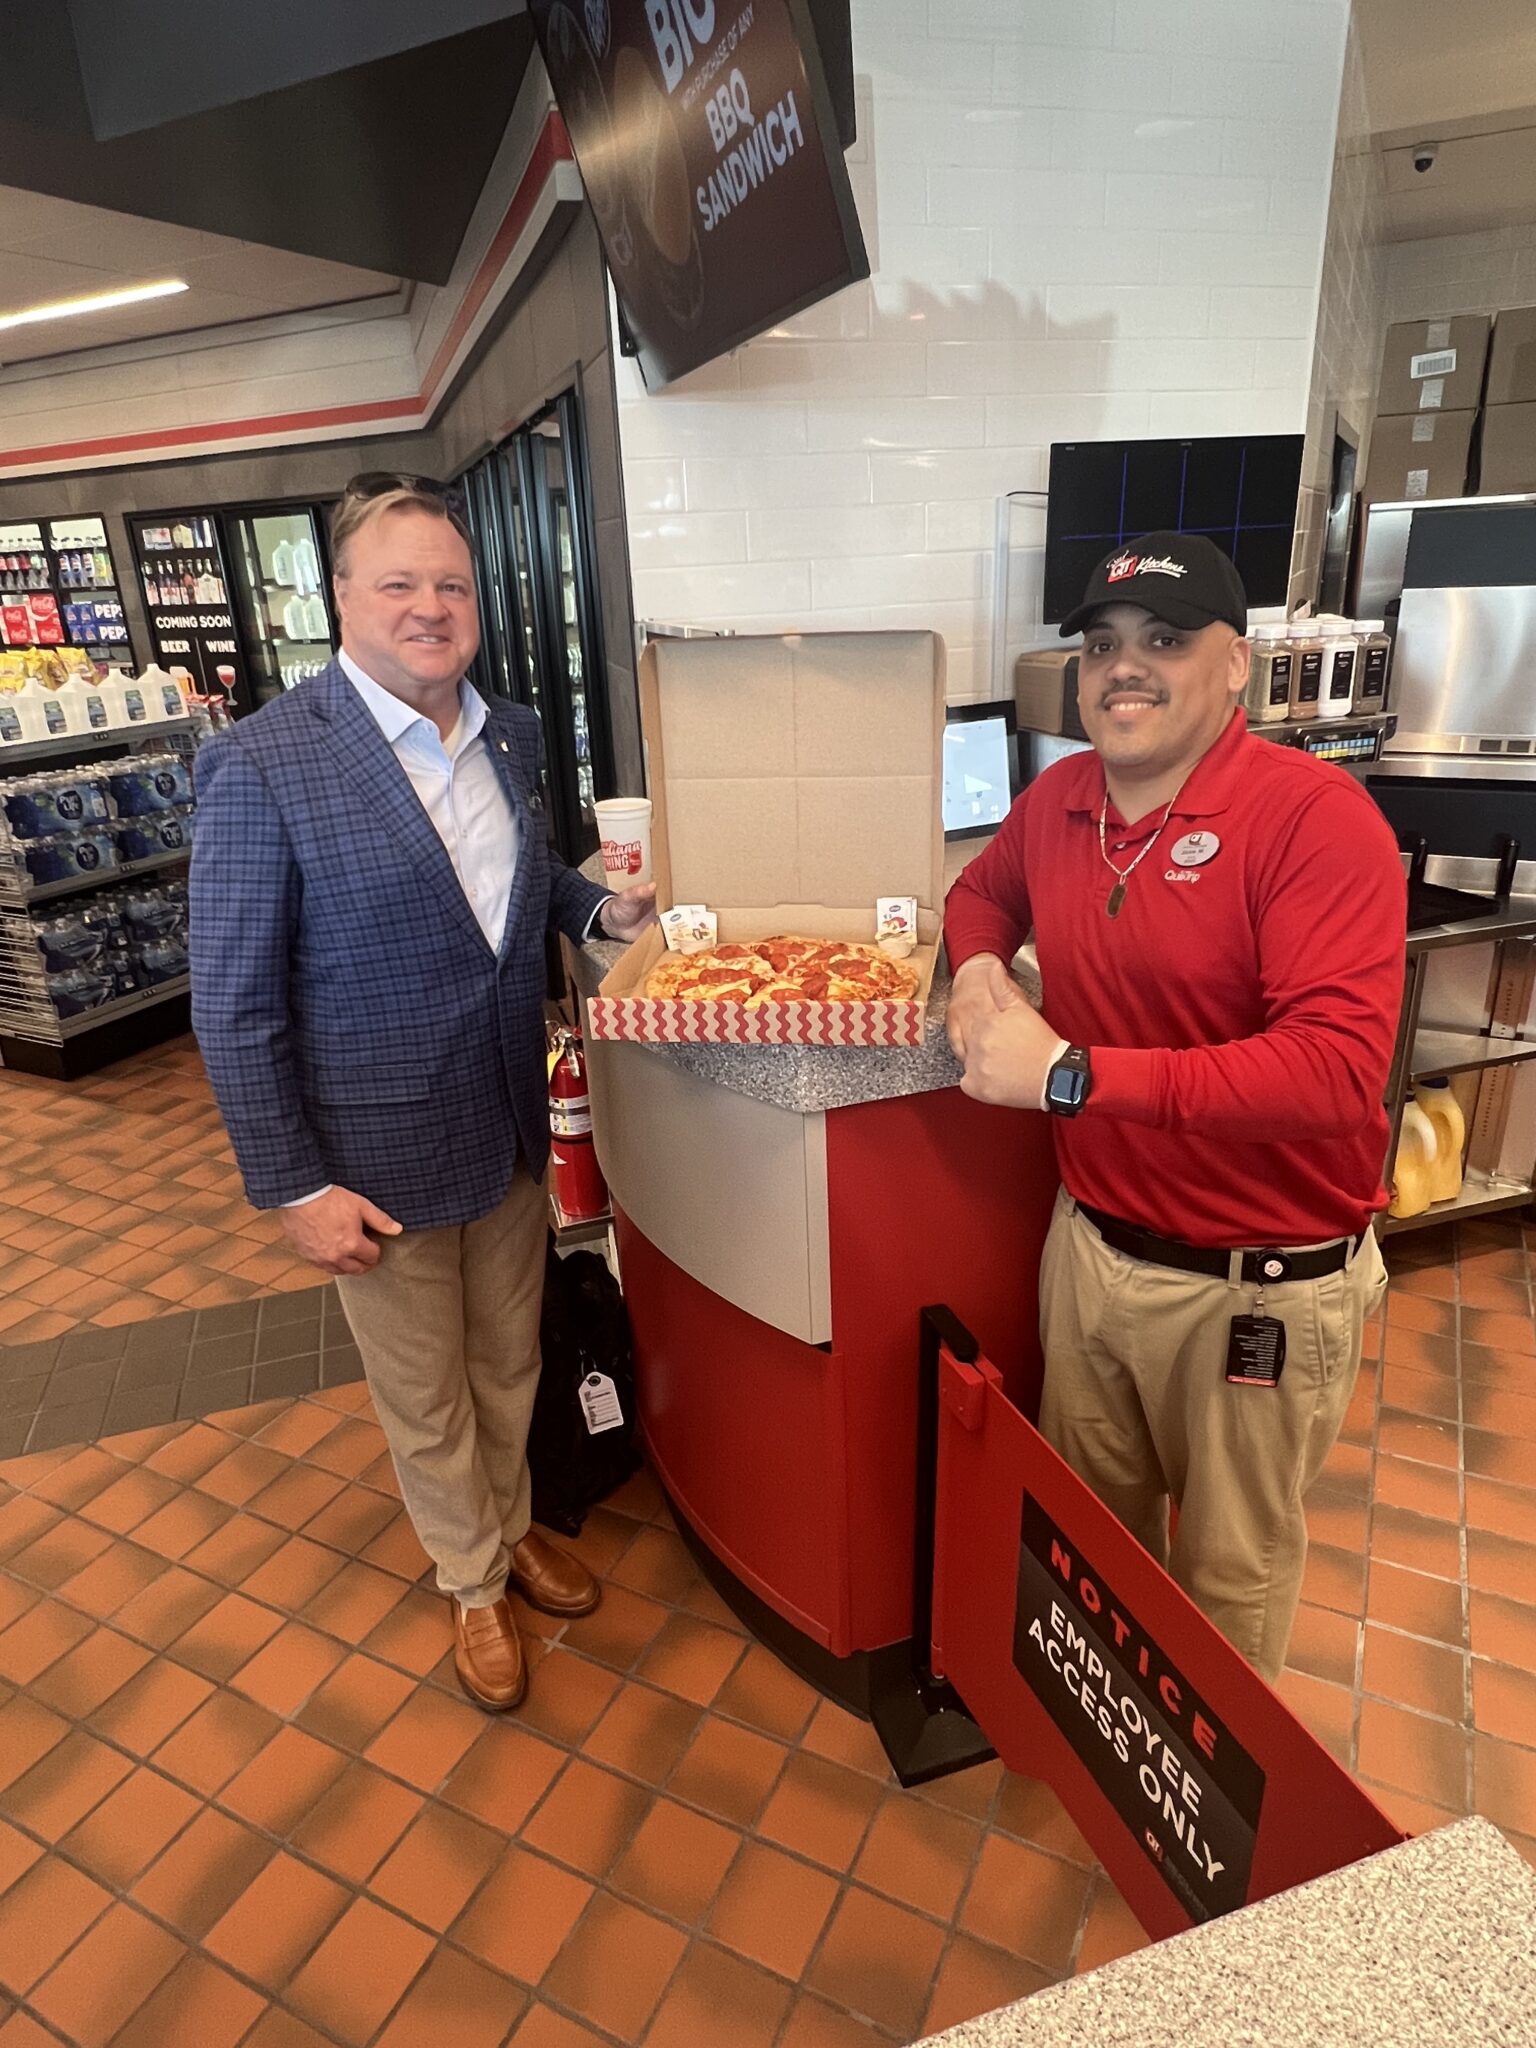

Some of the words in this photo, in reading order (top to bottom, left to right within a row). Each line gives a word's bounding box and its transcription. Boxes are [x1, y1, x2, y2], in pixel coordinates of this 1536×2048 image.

[696, 90, 804, 232] SANDWICH
[705, 67, 755, 153] BBQ
[156, 615, 199, 629] COMING
[199, 614, 232, 628] SOON
[160, 640, 191, 653] BEER
[205, 640, 237, 653] WINE
[1051, 1539, 1217, 1760] NOTICE
[1028, 1618, 1128, 1763] ACCESS
[1139, 1764, 1226, 1882] ONLY
[1050, 1601, 1202, 1816] EMPLOYEE
